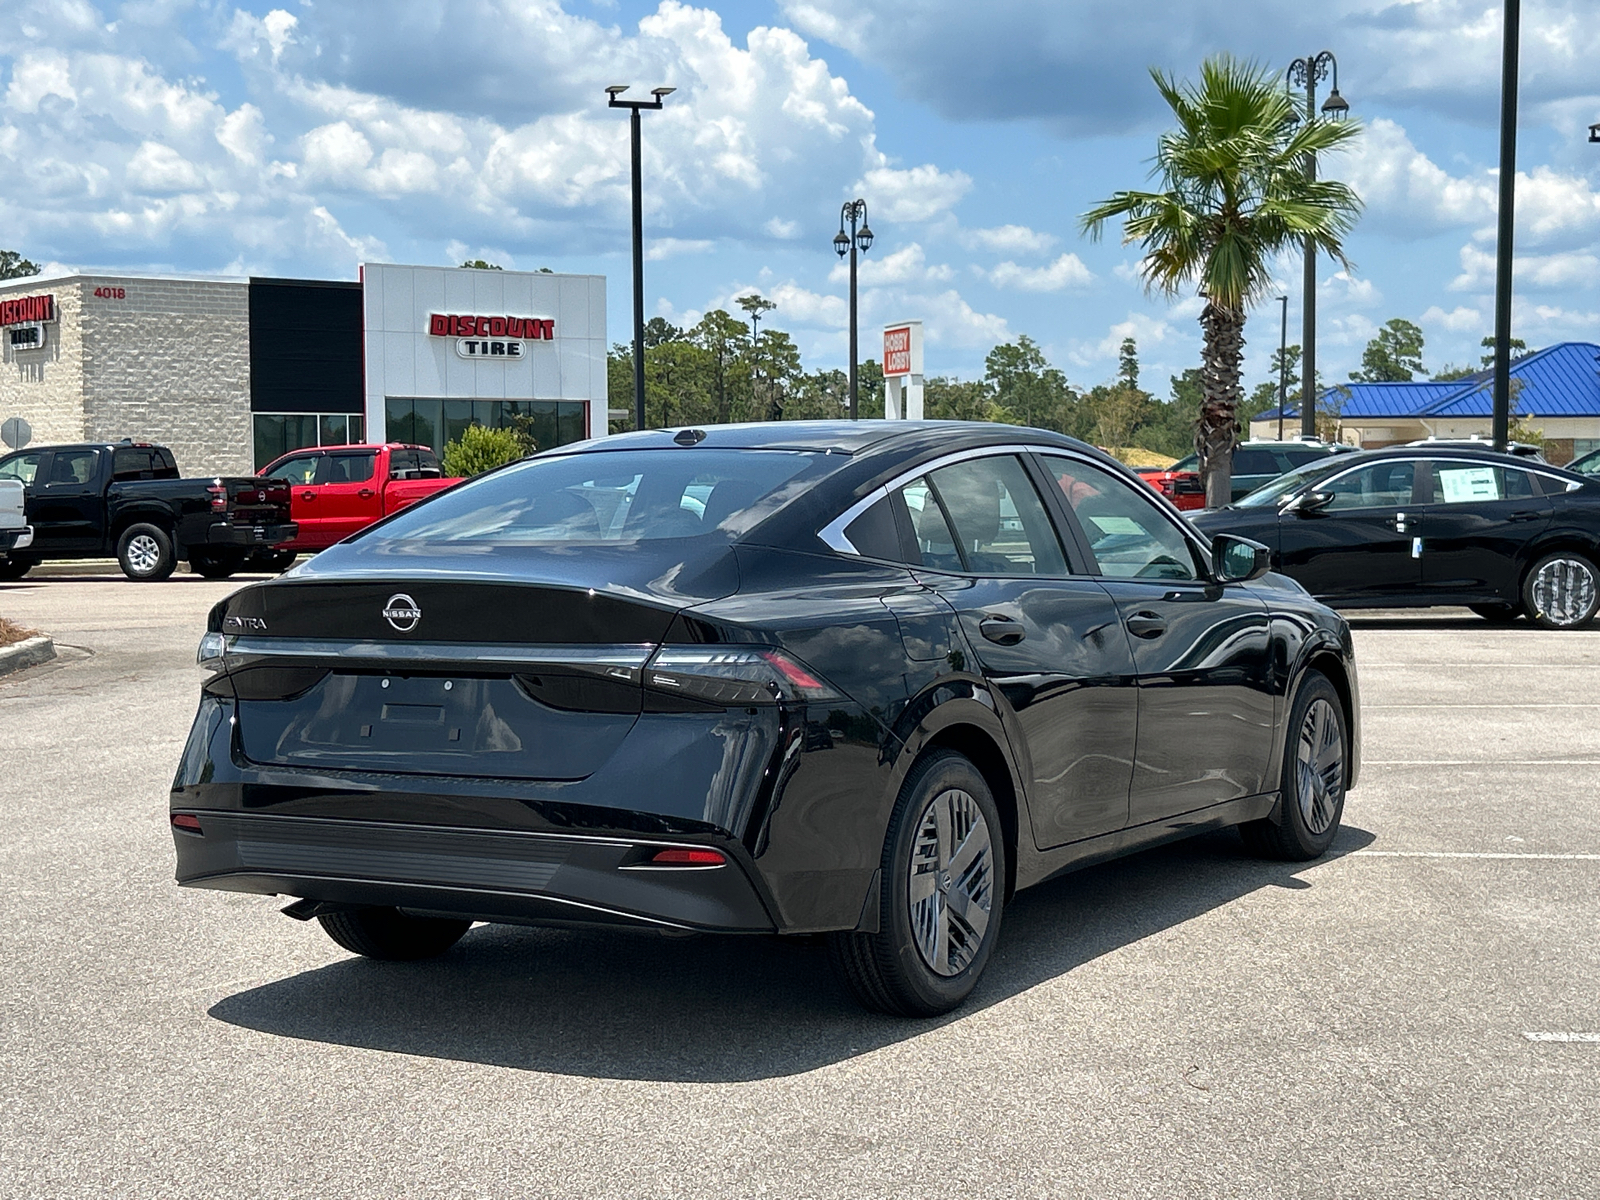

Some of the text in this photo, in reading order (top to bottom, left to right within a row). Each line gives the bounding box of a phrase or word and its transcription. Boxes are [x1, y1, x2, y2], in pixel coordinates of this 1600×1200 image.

[93, 287, 126, 300] 4018
[0, 294, 52, 326] ISCOUNT
[9, 327, 38, 345] TIRE
[430, 314, 555, 340] DISCOUNT
[465, 341, 521, 355] TIRE
[885, 332, 909, 352] HOBBY
[887, 352, 910, 371] LOBBY
[382, 609, 421, 618] NISSAN
